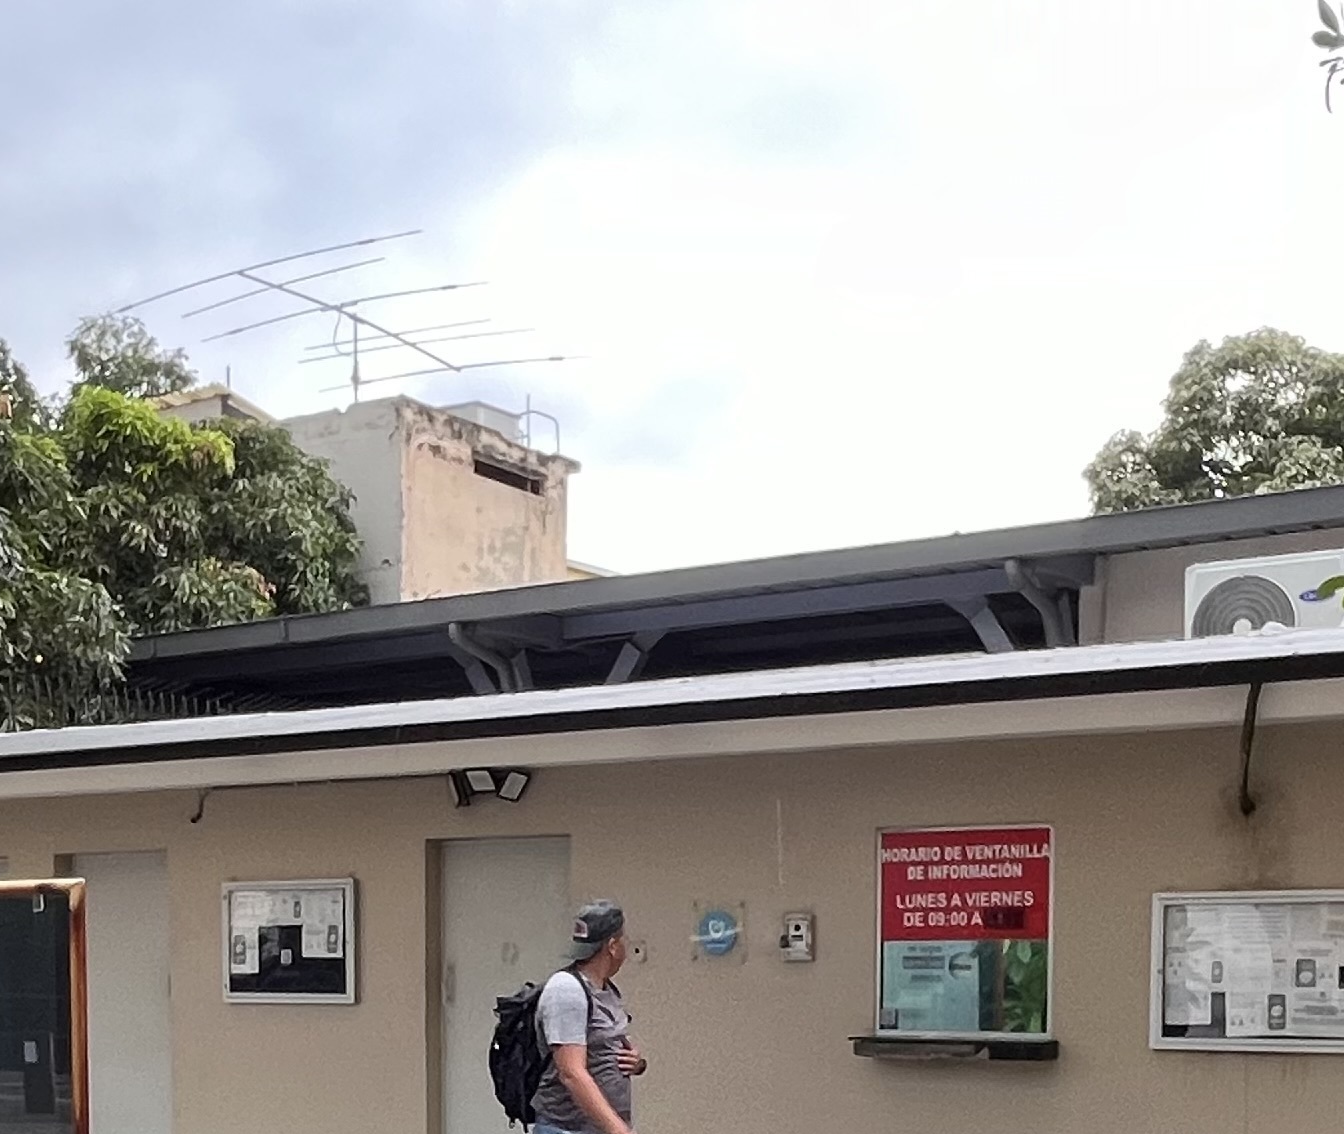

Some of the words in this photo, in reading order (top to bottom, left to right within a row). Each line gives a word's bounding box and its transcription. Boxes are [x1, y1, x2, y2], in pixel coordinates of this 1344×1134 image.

[881, 847, 941, 863] HORARIO
[944, 846, 962, 861] DE
[965, 843, 1050, 860] VENTANILLA
[907, 866, 925, 880] DE
[928, 861, 1023, 880] INFORMACIÓN
[896, 892, 947, 909] LUNES
[951, 892, 962, 908] A
[965, 890, 1034, 908] VIERNES
[903, 911, 925, 927] DE
[928, 911, 968, 926] 09:00
[971, 910, 984, 926] A
